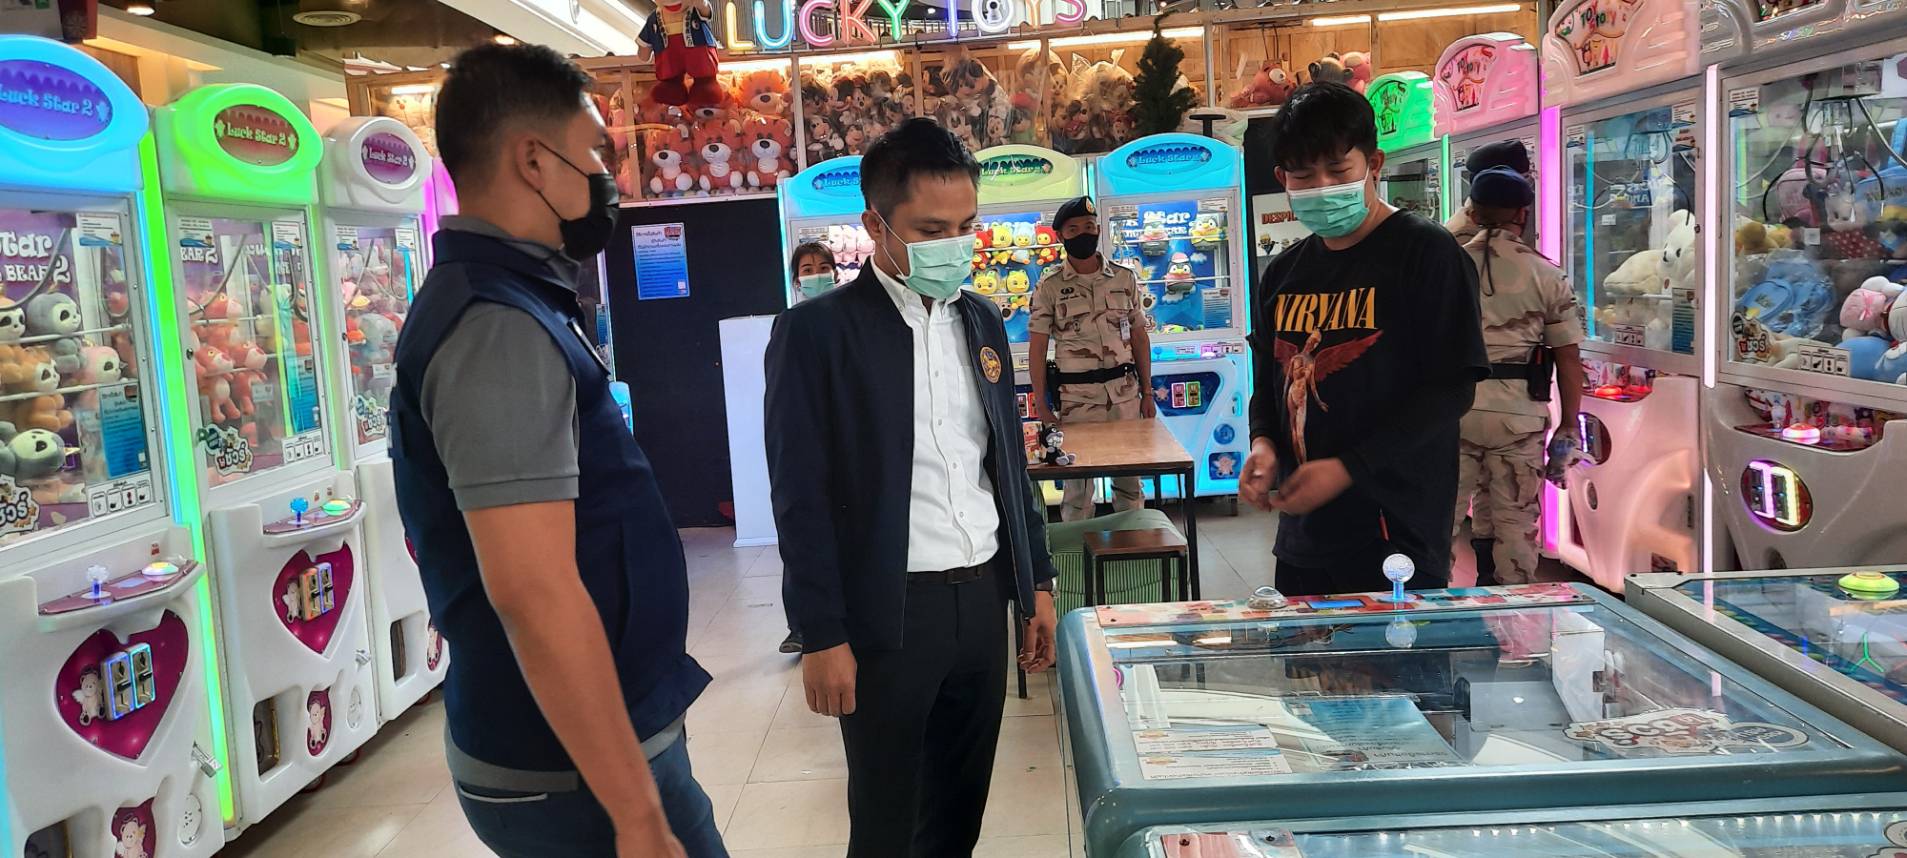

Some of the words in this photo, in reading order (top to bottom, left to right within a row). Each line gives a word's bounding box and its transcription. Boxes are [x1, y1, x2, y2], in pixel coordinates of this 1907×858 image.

[726, 0, 909, 50] LUCKY
[43, 92, 80, 114] Star
[81, 98, 93, 117] 2
[227, 121, 253, 140] Luck
[254, 127, 278, 146] Star
[0, 230, 53, 258] tar
[1274, 287, 1379, 334] NIRVANA
